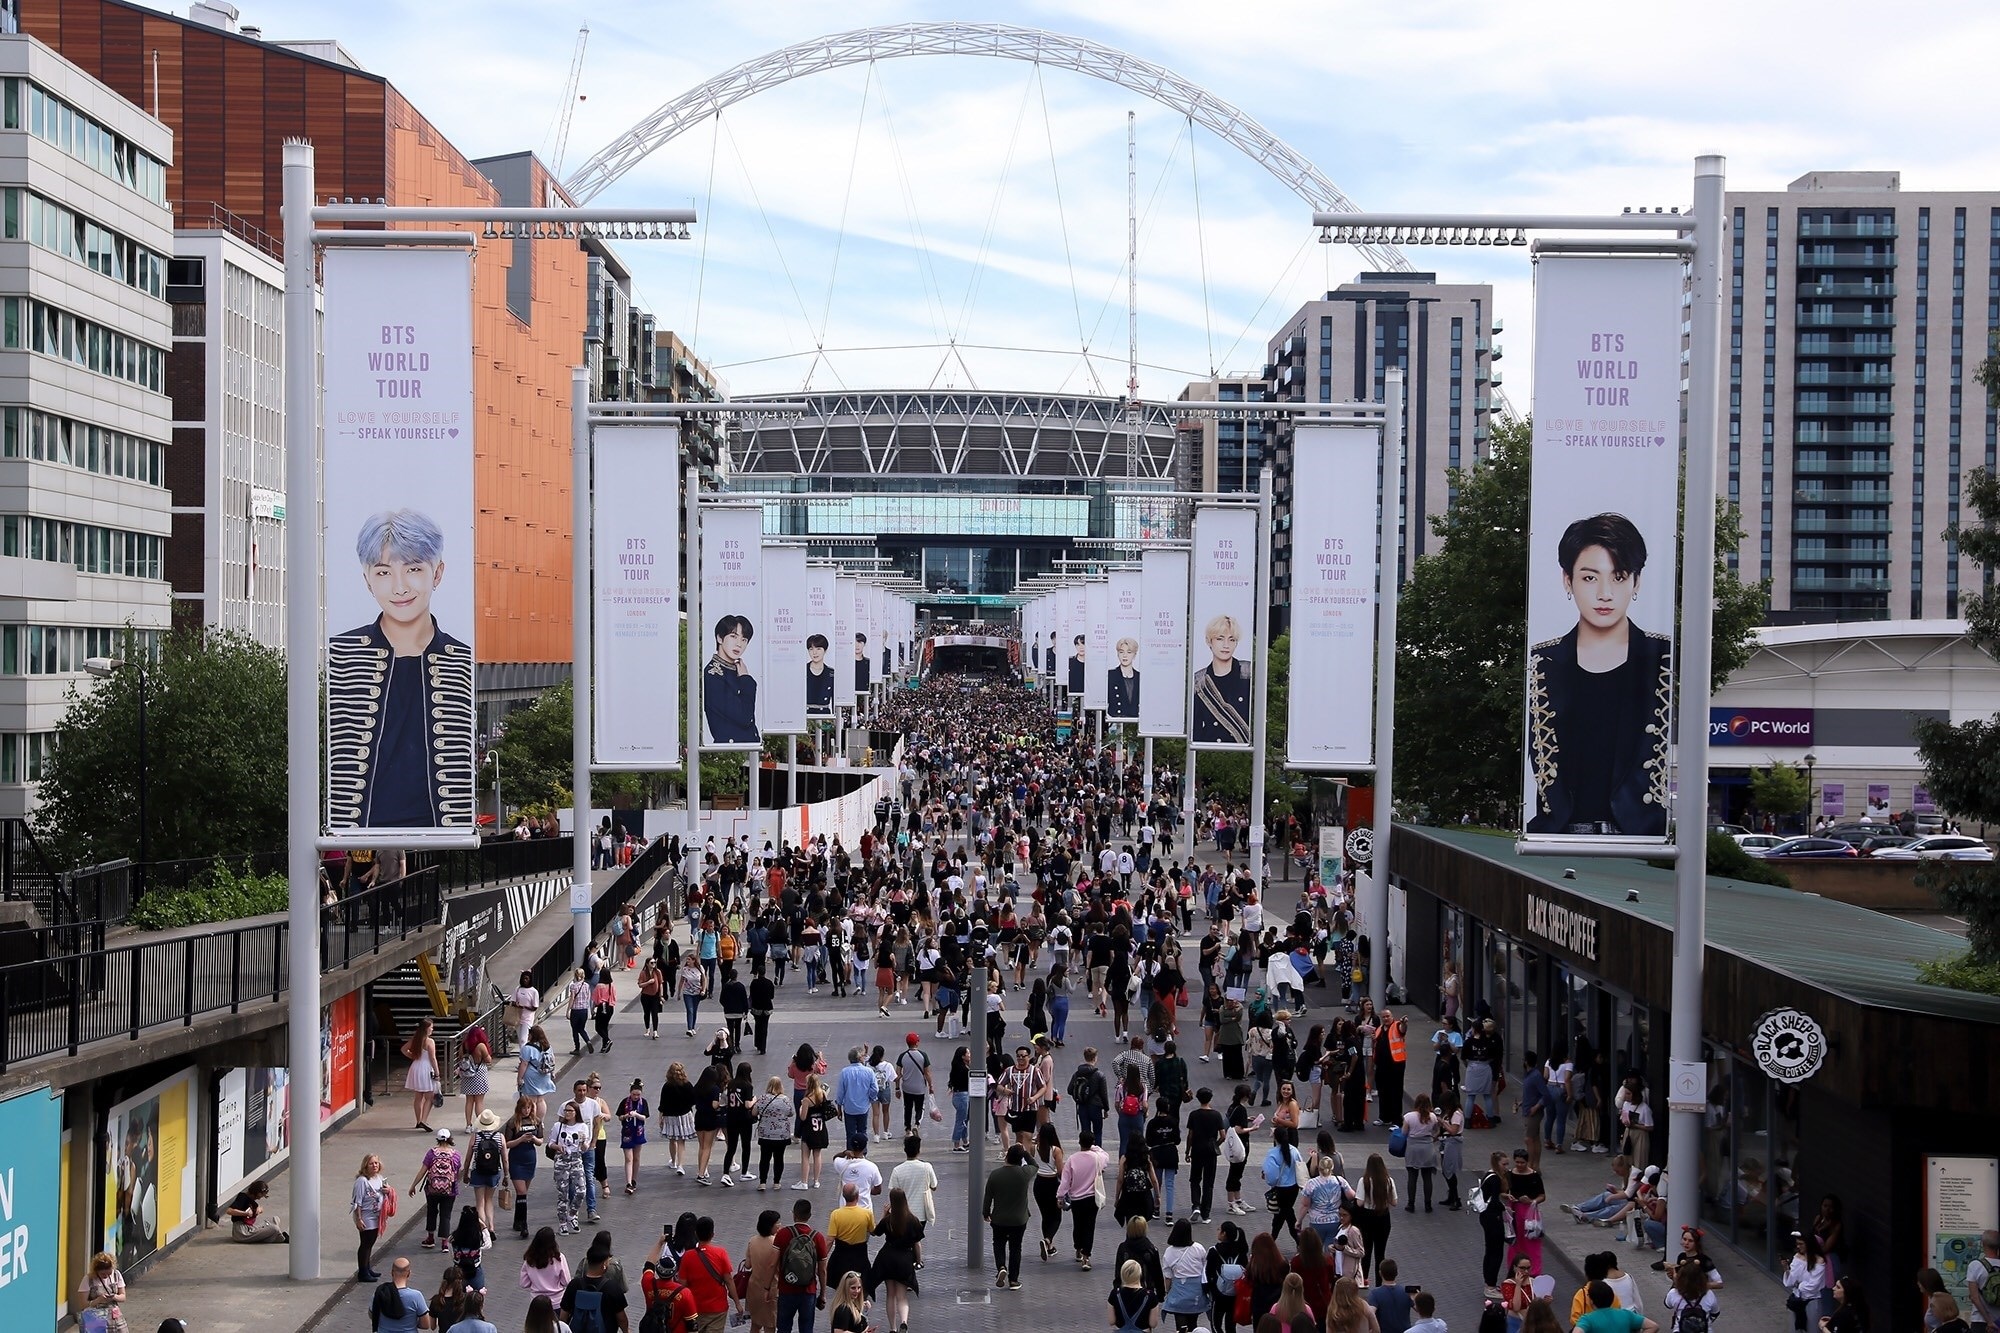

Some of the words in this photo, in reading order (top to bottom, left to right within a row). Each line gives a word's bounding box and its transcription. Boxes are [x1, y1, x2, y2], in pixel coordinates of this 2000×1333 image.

[381, 325, 415, 345] BTS
[1591, 333, 1625, 353] BTS
[368, 352, 430, 372] WORLD
[1577, 360, 1638, 380] WORLD
[376, 379, 422, 399] TOUR
[1584, 387, 1630, 407] TOUR
[337, 411, 376, 424] LOVE
[382, 411, 460, 424] YOURSELF
[1545, 418, 1584, 432] LOVE
[1589, 419, 1667, 433] YOURSELF
[358, 427, 391, 440] SPEAK
[394, 427, 446, 440] YOURSELF
[1565, 435, 1598, 448] SPEAK
[1601, 435, 1652, 448] YOURSELF
[979, 499, 1020, 512] LONDON
[626, 538, 646, 550] BTS
[724, 540, 739, 549] BTS
[1218, 539, 1233, 549] BTS
[1324, 538, 1344, 550] BTS
[619, 553, 654, 565] WORLD
[719, 551, 745, 560] WORLD
[1213, 550, 1239, 560] WORLD
[1316, 553, 1352, 566] WORLD
[722, 561, 742, 571] TOUR
[1216, 561, 1235, 570] TOUR
[623, 569, 650, 581] TOUR
[1320, 569, 1347, 581] TOUR
[613, 596, 632, 604] SPEAK
[633, 596, 663, 604] YOURSELF
[1309, 596, 1329, 604] SPEAK
[1330, 596, 1359, 604] YOURSELF
[1158, 611, 1170, 619] BTS
[1751, 721, 1770, 733] PC
[1771, 721, 1810, 734] World
[1347, 831, 1360, 847] BLACK
[1121, 855, 1128, 863] 8
[1527, 893, 1548, 939] BLACK
[1548, 902, 1569, 948] SHEEP
[1568, 911, 1596, 961] COFFEE
[831, 938, 840, 947] 93
[1757, 1018, 1783, 1051] BLACK
[1781, 1015, 1814, 1034] SHEEP
[1785, 1060, 1814, 1078] COFFEE
[811, 1117, 823, 1132] 97
[0, 1224, 29, 1289] ER
